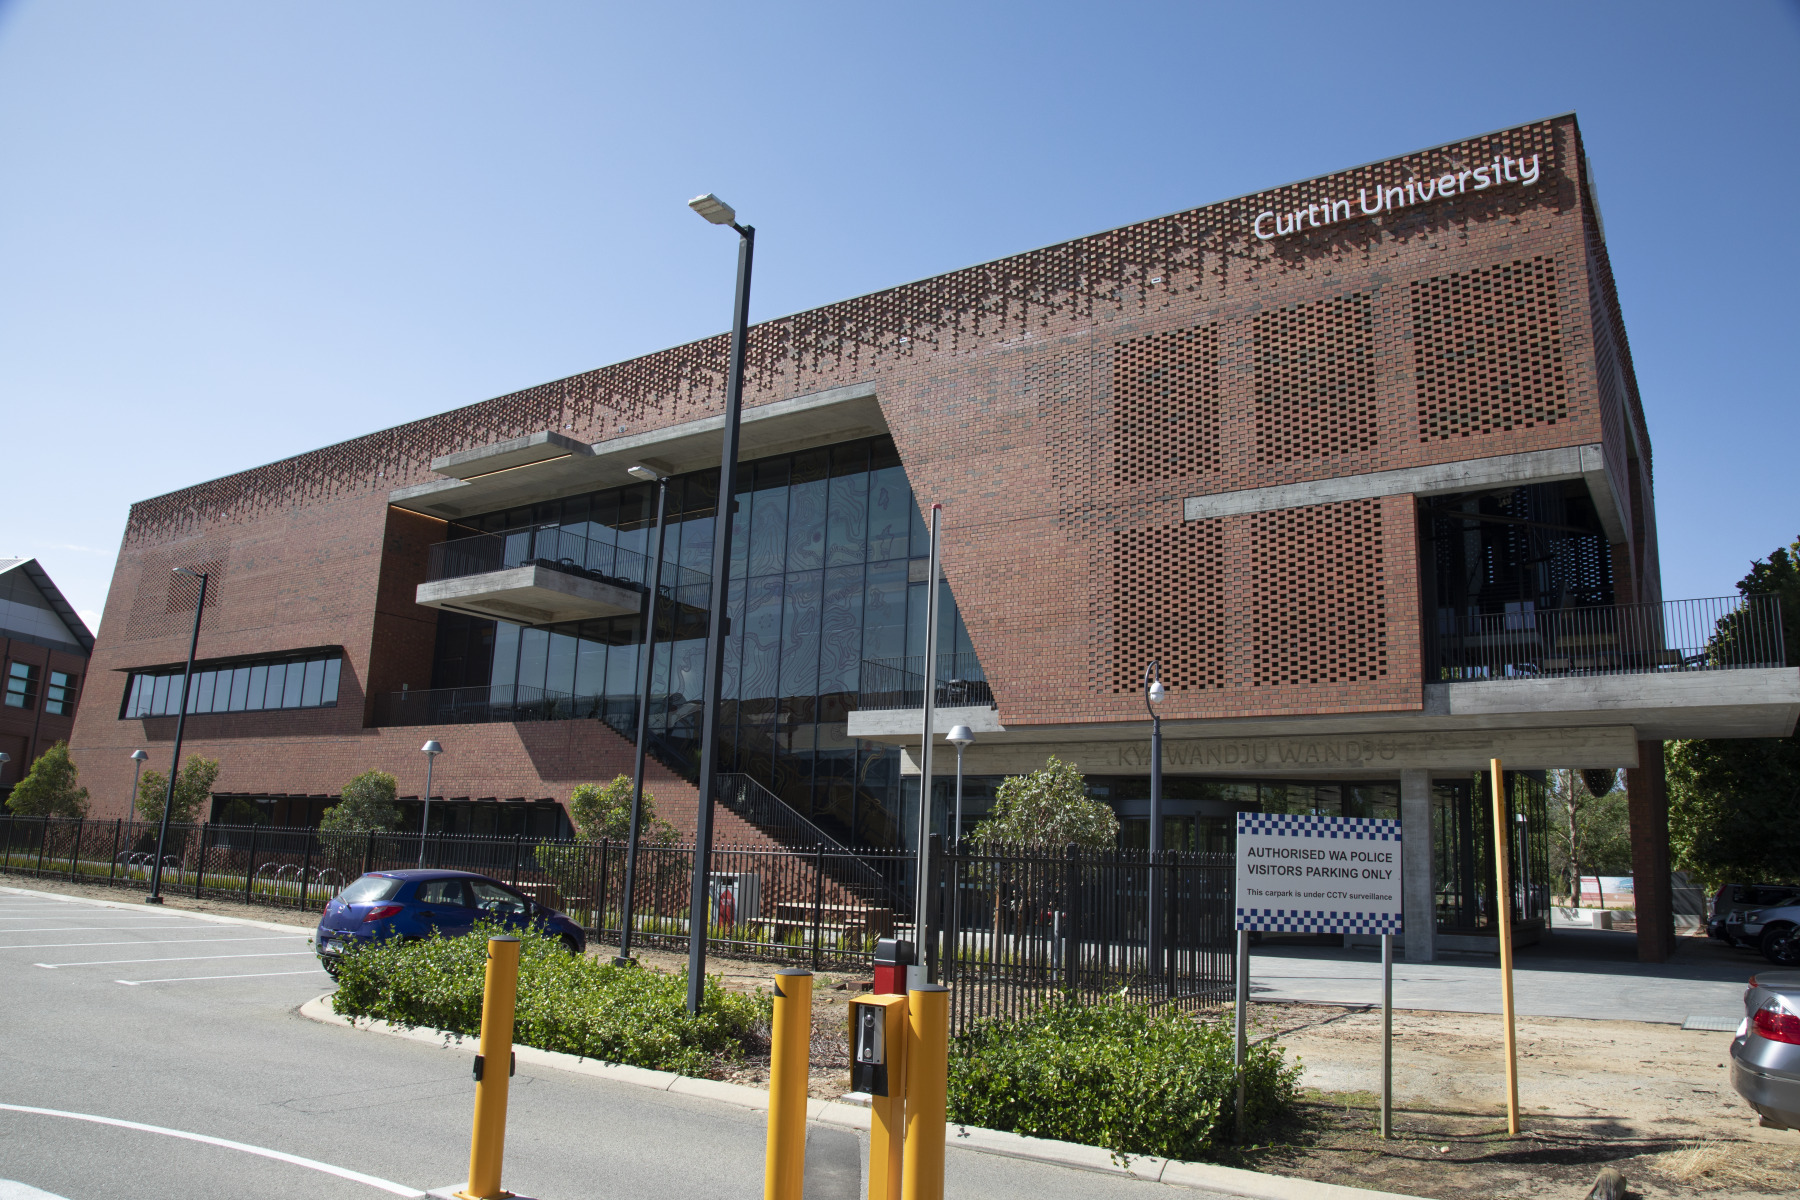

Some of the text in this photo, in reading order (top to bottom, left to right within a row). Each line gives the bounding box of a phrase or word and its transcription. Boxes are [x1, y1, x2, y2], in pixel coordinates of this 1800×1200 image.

[1254, 154, 1540, 240] Curtin University
[1166, 743, 1268, 765] WANDJU
[1278, 740, 1397, 762] WANDJU
[1247, 847, 1393, 863] AUTHORISED WA POLICE
[1247, 864, 1393, 880] VISITORS PARKING ONLY
[1247, 888, 1393, 901] This carpark is under CCTV surveillance
